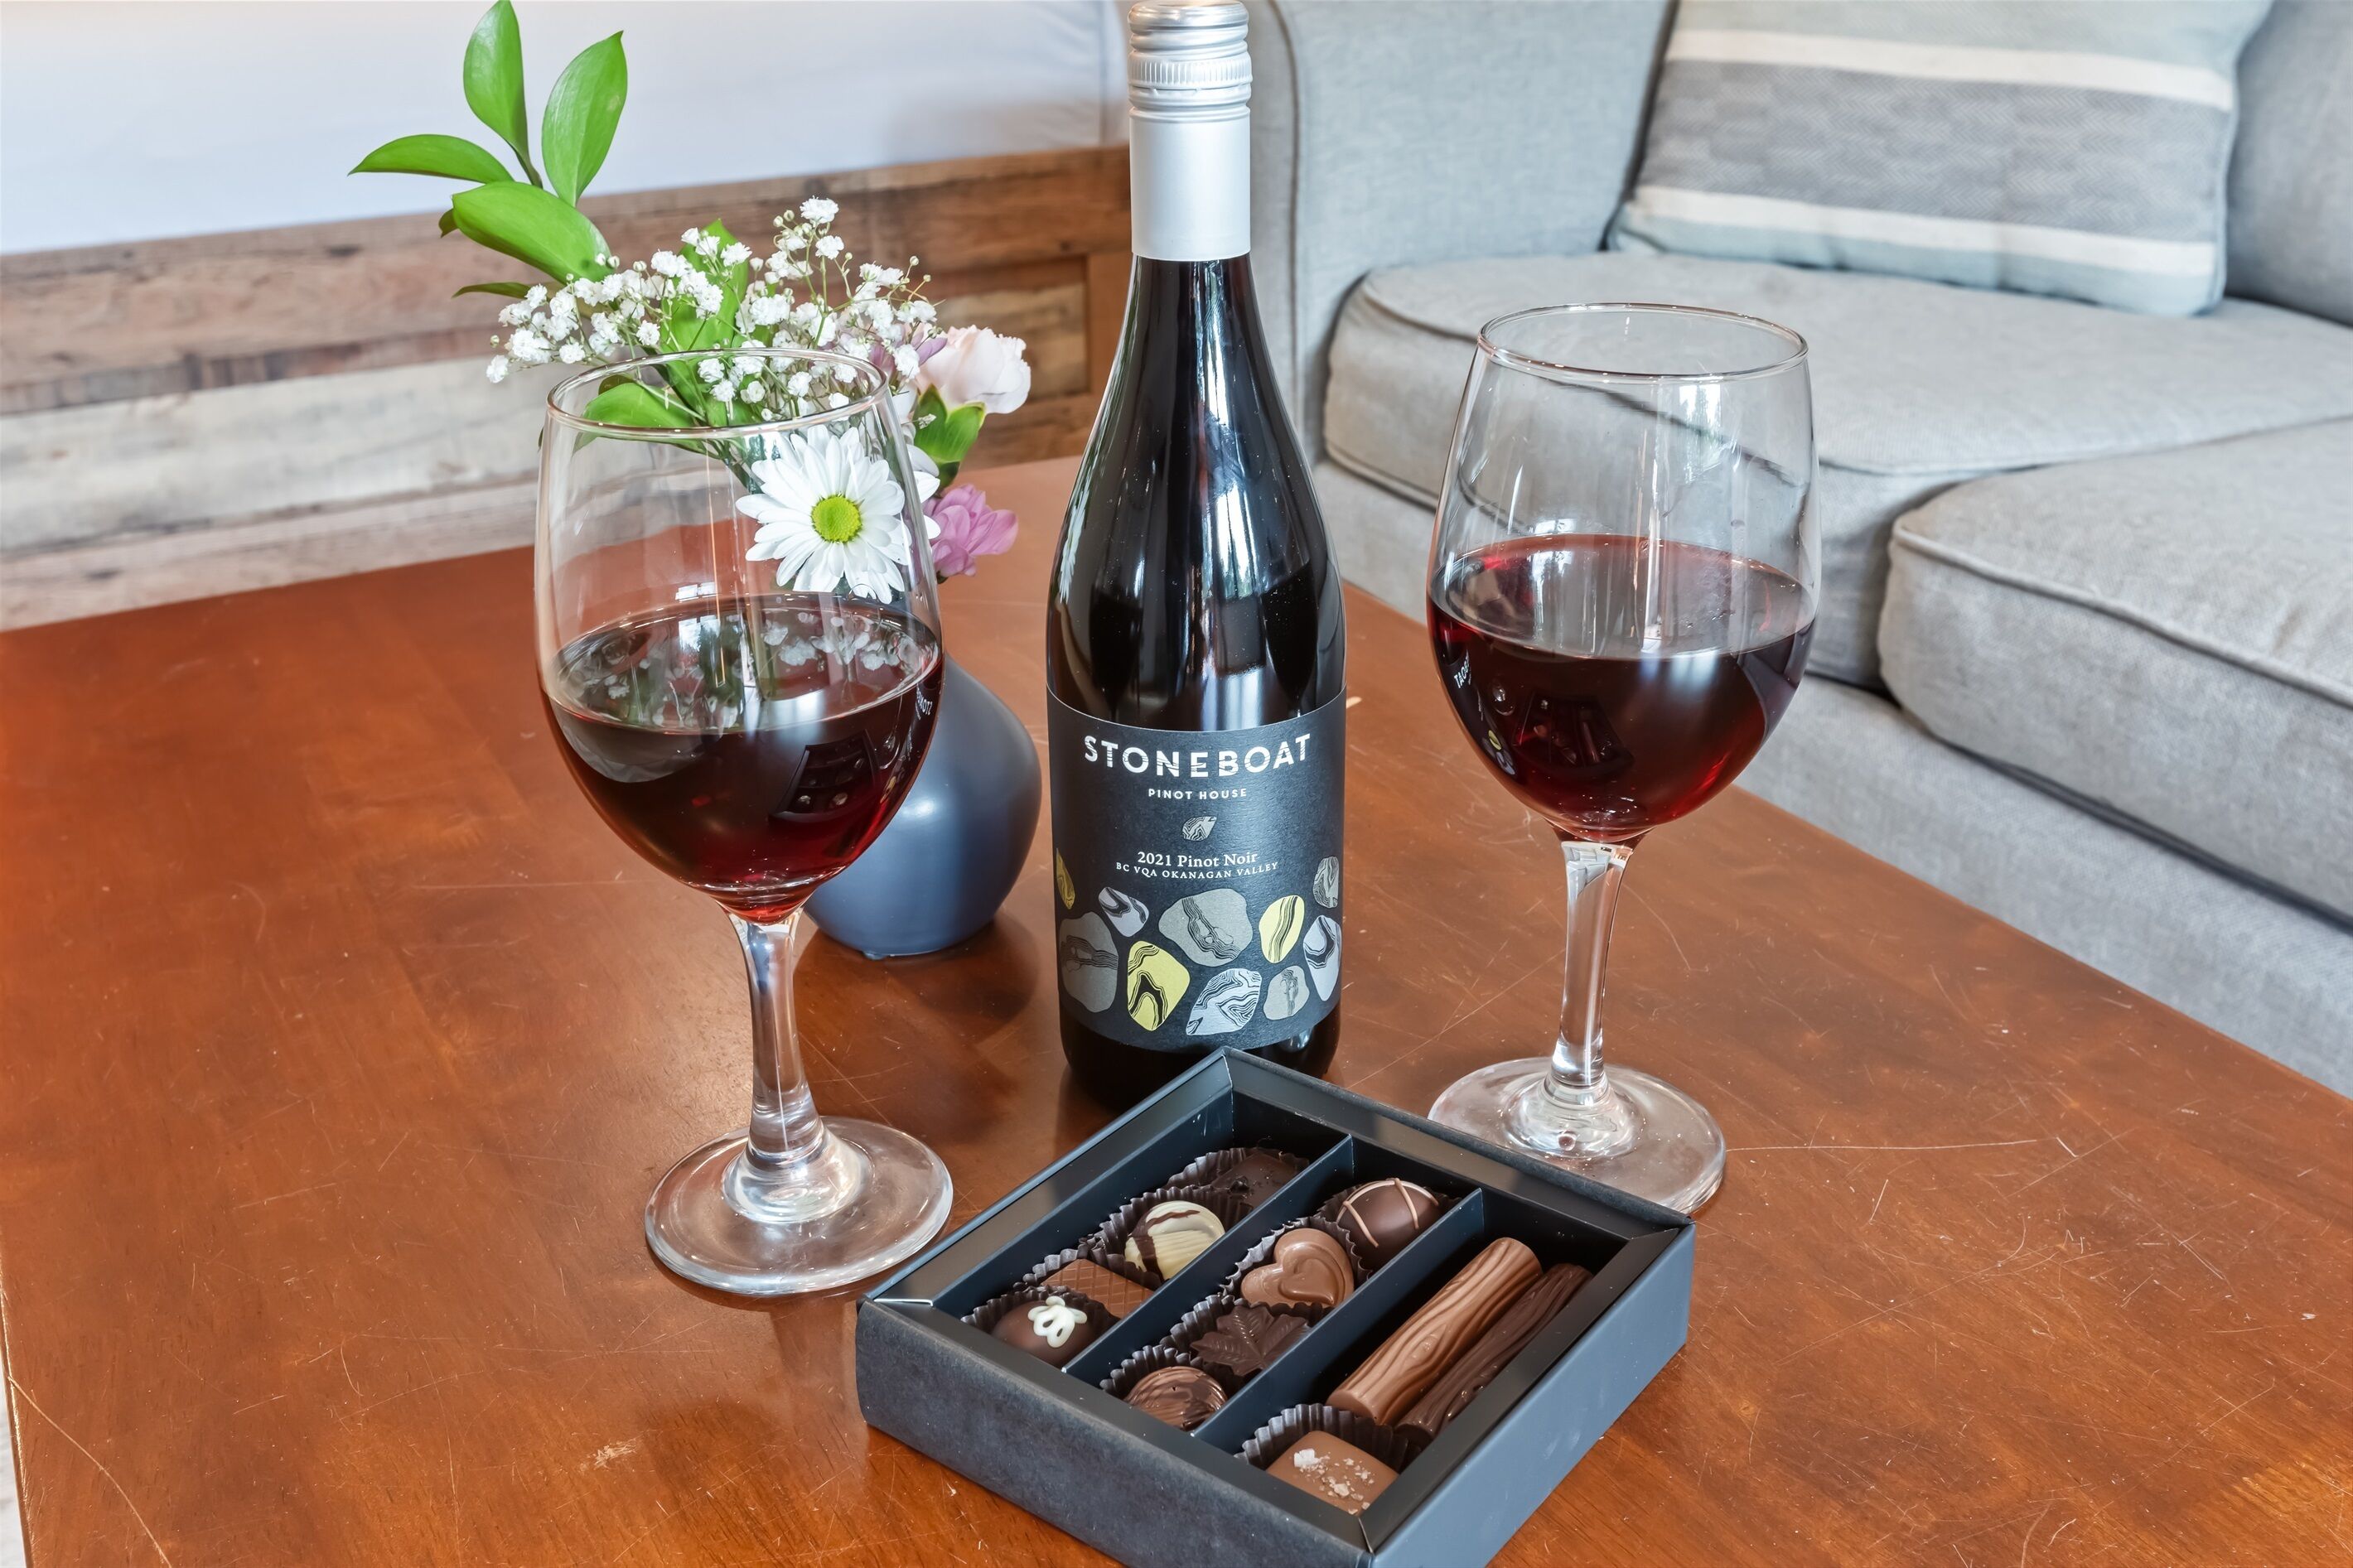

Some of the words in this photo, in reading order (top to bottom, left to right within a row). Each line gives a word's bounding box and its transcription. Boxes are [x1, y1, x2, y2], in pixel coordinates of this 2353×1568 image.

[1084, 734, 1312, 778] STONEBOAT
[1148, 789, 1192, 800] PINOT
[1199, 788, 1247, 800] HOUSE
[1138, 852, 1172, 867] 2021
[1177, 854, 1220, 867] Pinot
[1224, 852, 1258, 866] Noir
[1116, 862, 1130, 872] BC
[1134, 866, 1158, 878] VQA
[1162, 870, 1232, 879] OKANAGAN
[1237, 861, 1278, 876] VALLEY
